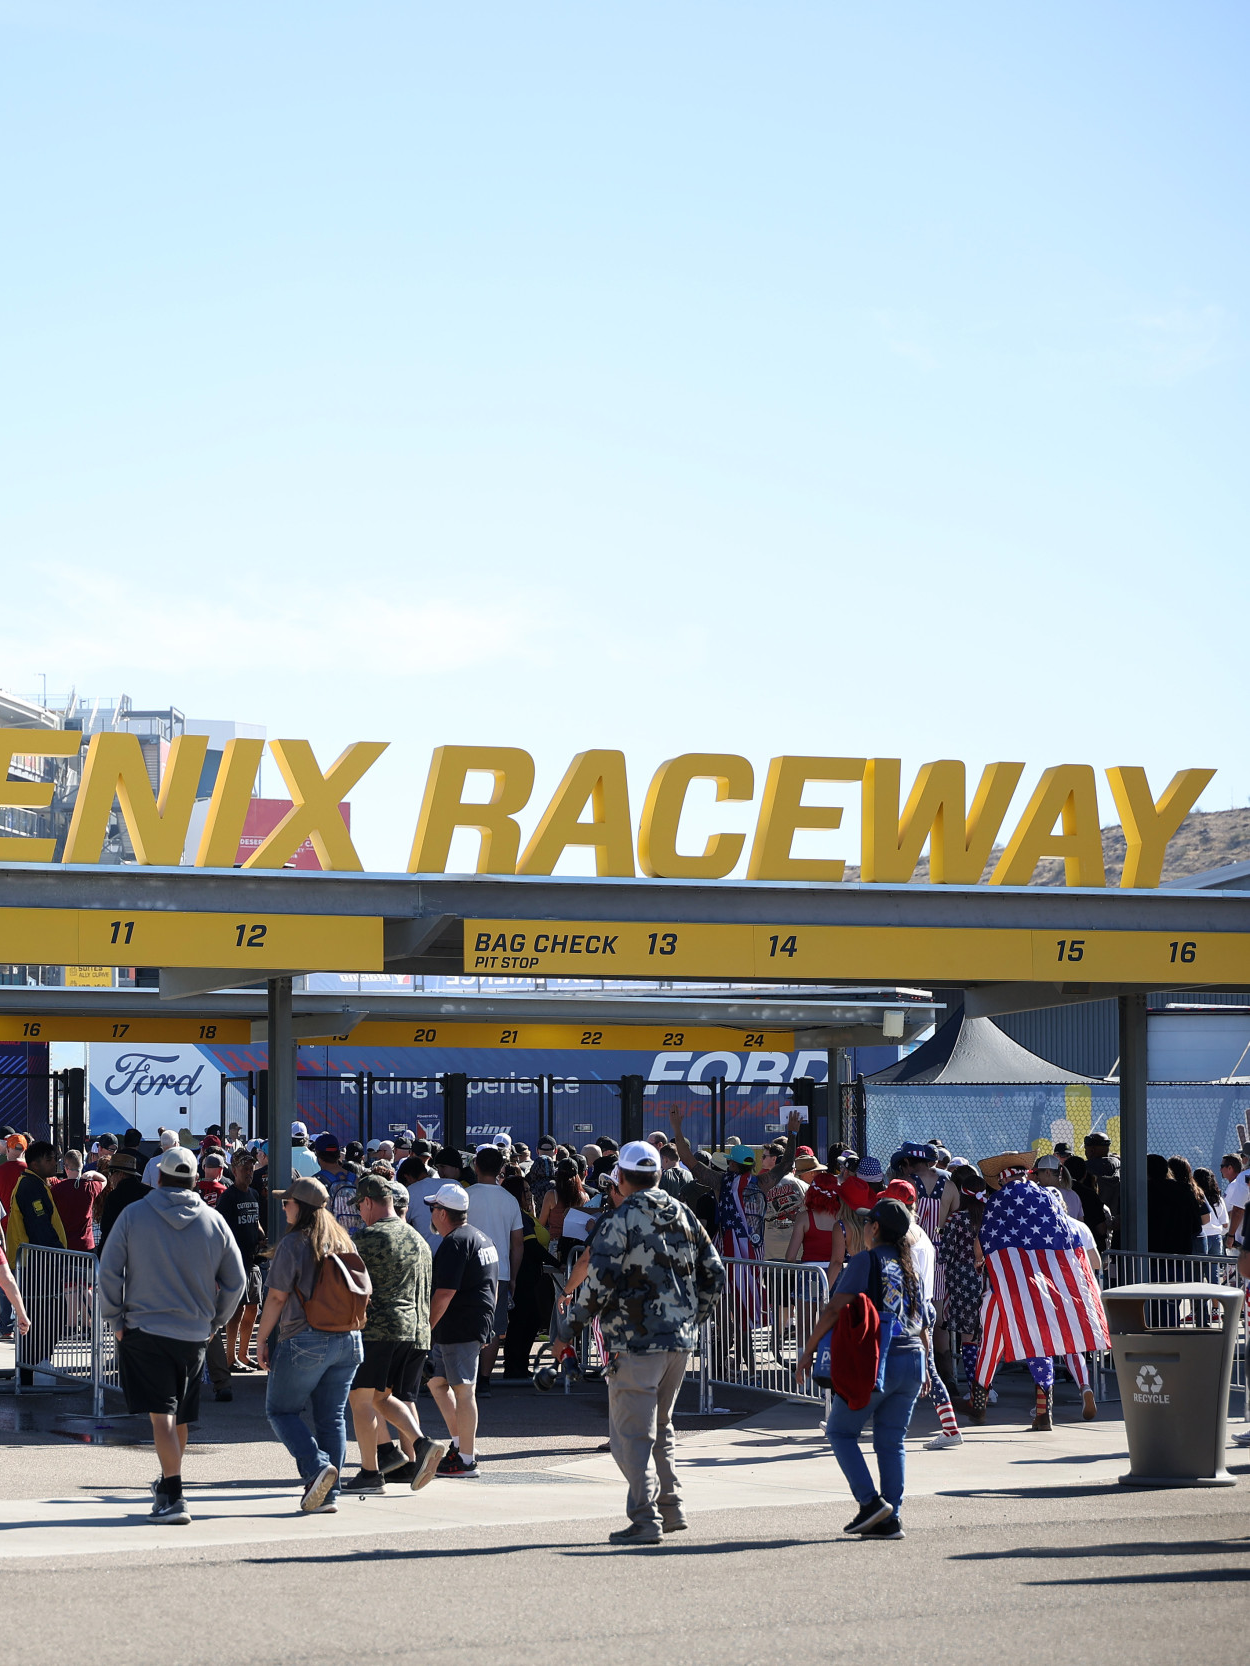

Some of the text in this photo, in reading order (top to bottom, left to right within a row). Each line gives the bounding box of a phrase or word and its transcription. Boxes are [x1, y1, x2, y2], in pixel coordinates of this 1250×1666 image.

[406, 745, 1218, 887] RACEWAY
[240, 838, 265, 846] DESER
[110, 921, 268, 948] 11 12
[474, 932, 1197, 964] BAG CHECK 13 14 15 16
[474, 956, 540, 970] PIT STOP
[23, 1022, 42, 1037] 16
[112, 1023, 131, 1038] 17
[199, 1025, 218, 1040] 18
[413, 1028, 765, 1047] 20 21 22 23 24
[105, 1053, 205, 1096] Ford
[435, 1072, 580, 1098] Eperience
[643, 1100, 794, 1117] PERFORMA
[1133, 1392, 1171, 1404] RECYCLE
